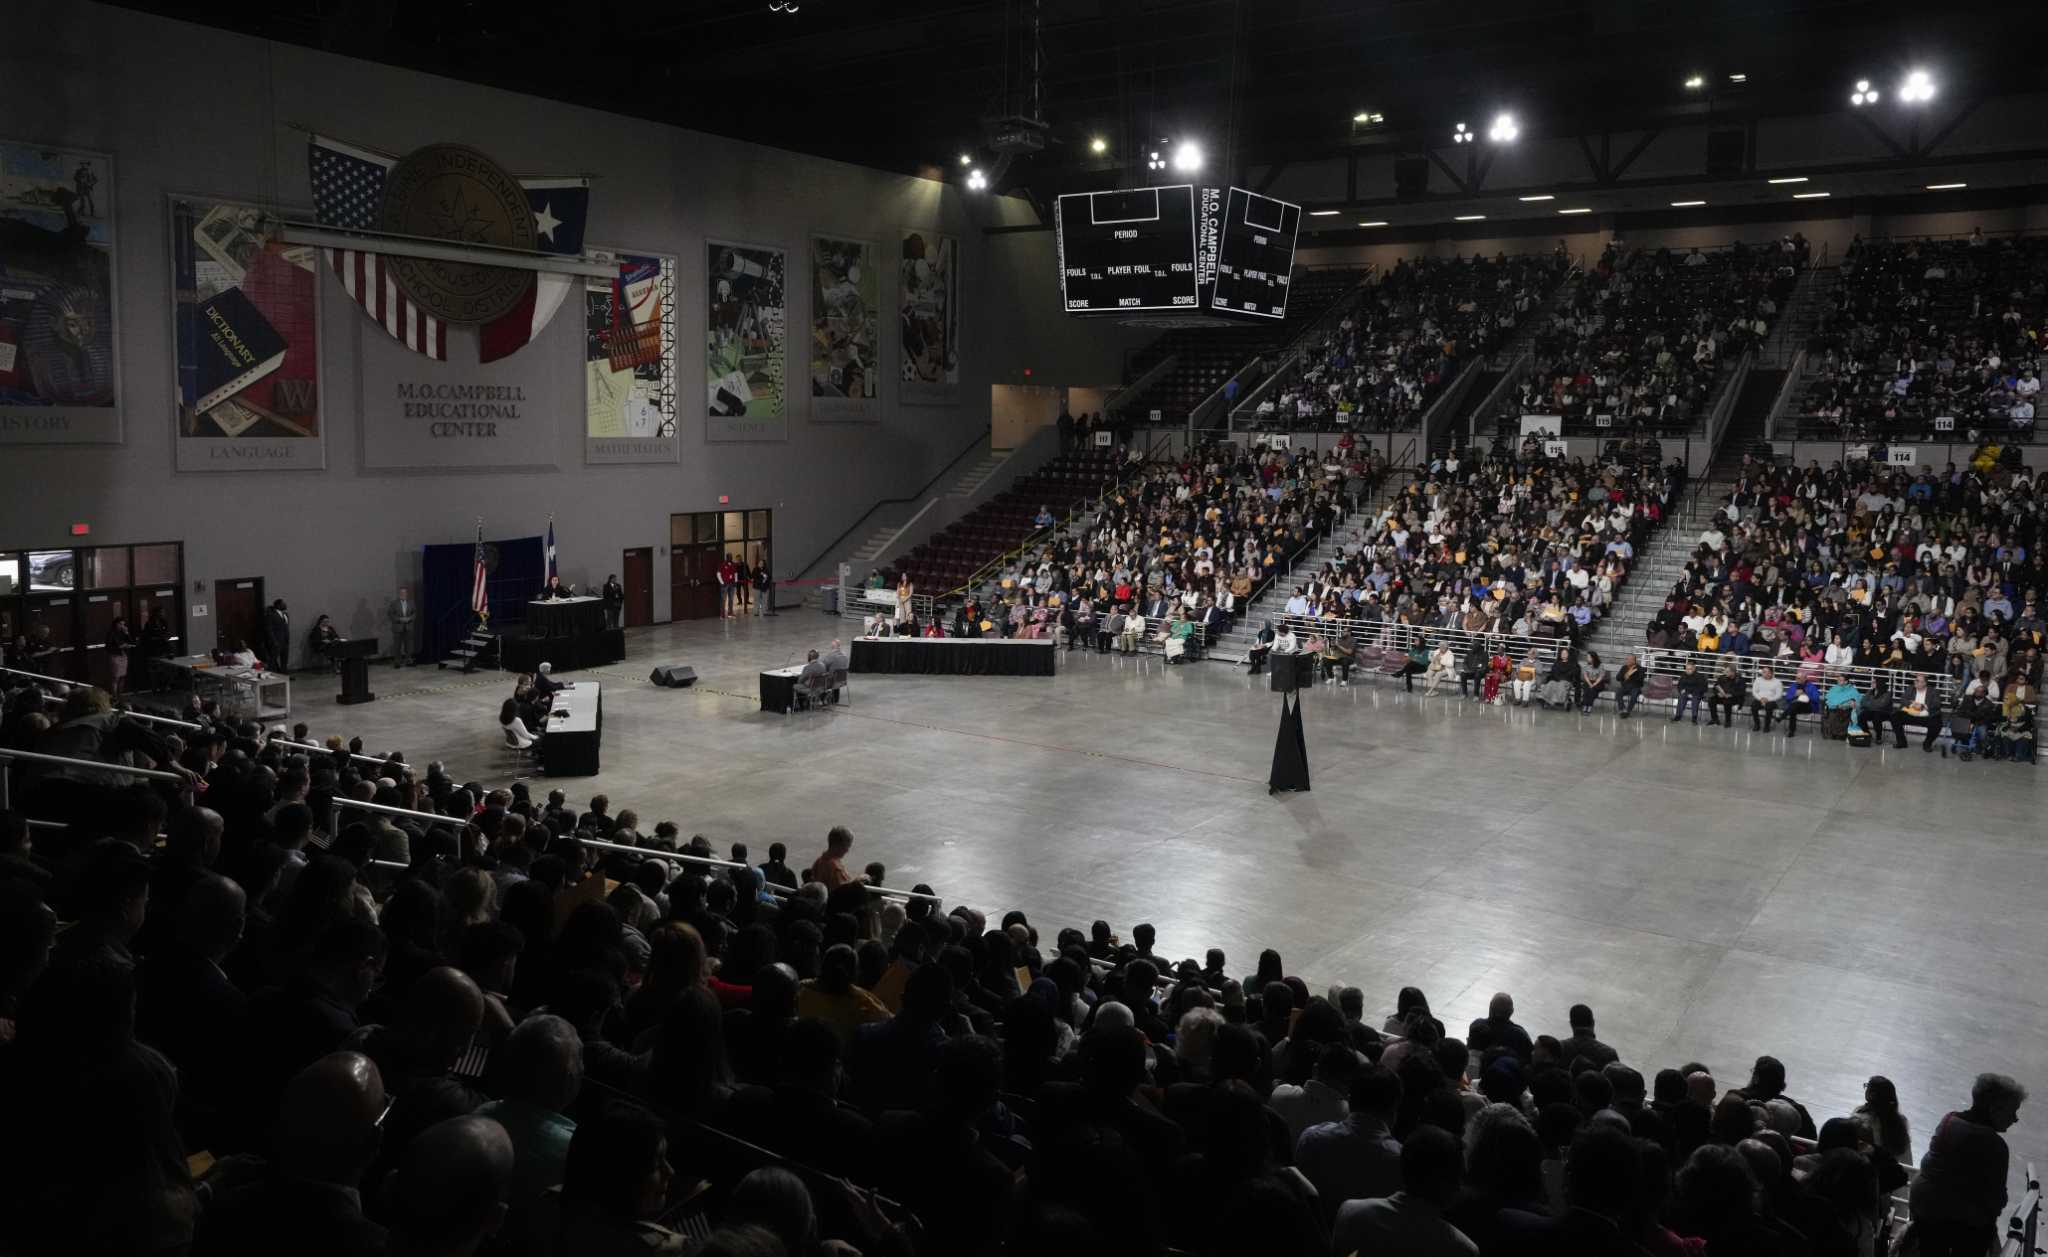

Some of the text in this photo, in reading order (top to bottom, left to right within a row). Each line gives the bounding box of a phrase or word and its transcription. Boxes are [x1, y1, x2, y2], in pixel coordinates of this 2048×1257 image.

[437, 153, 529, 239] INDEPENDENT
[1114, 229, 1138, 239] PERIOD
[1198, 188, 1209, 285] EDUCATIONAL CENTER
[1205, 188, 1220, 285] M.O. CAMPBELL
[1066, 267, 1087, 277] FOULS
[1107, 264, 1151, 275] PLAYER FOUL
[1171, 262, 1193, 272] FOULS
[1069, 299, 1089, 308] SCORE
[1118, 298, 1141, 306] MATCH
[1172, 295, 1195, 304] SCORE
[205, 304, 256, 363] DICTIONARY
[404, 402, 521, 419] EDUCATIONAL
[0, 416, 72, 432] ISTORY
[1937, 421, 1953, 429] 114
[430, 422, 497, 438] CENTER
[1549, 446, 1563, 454] 115
[1893, 452, 1911, 461] 114
